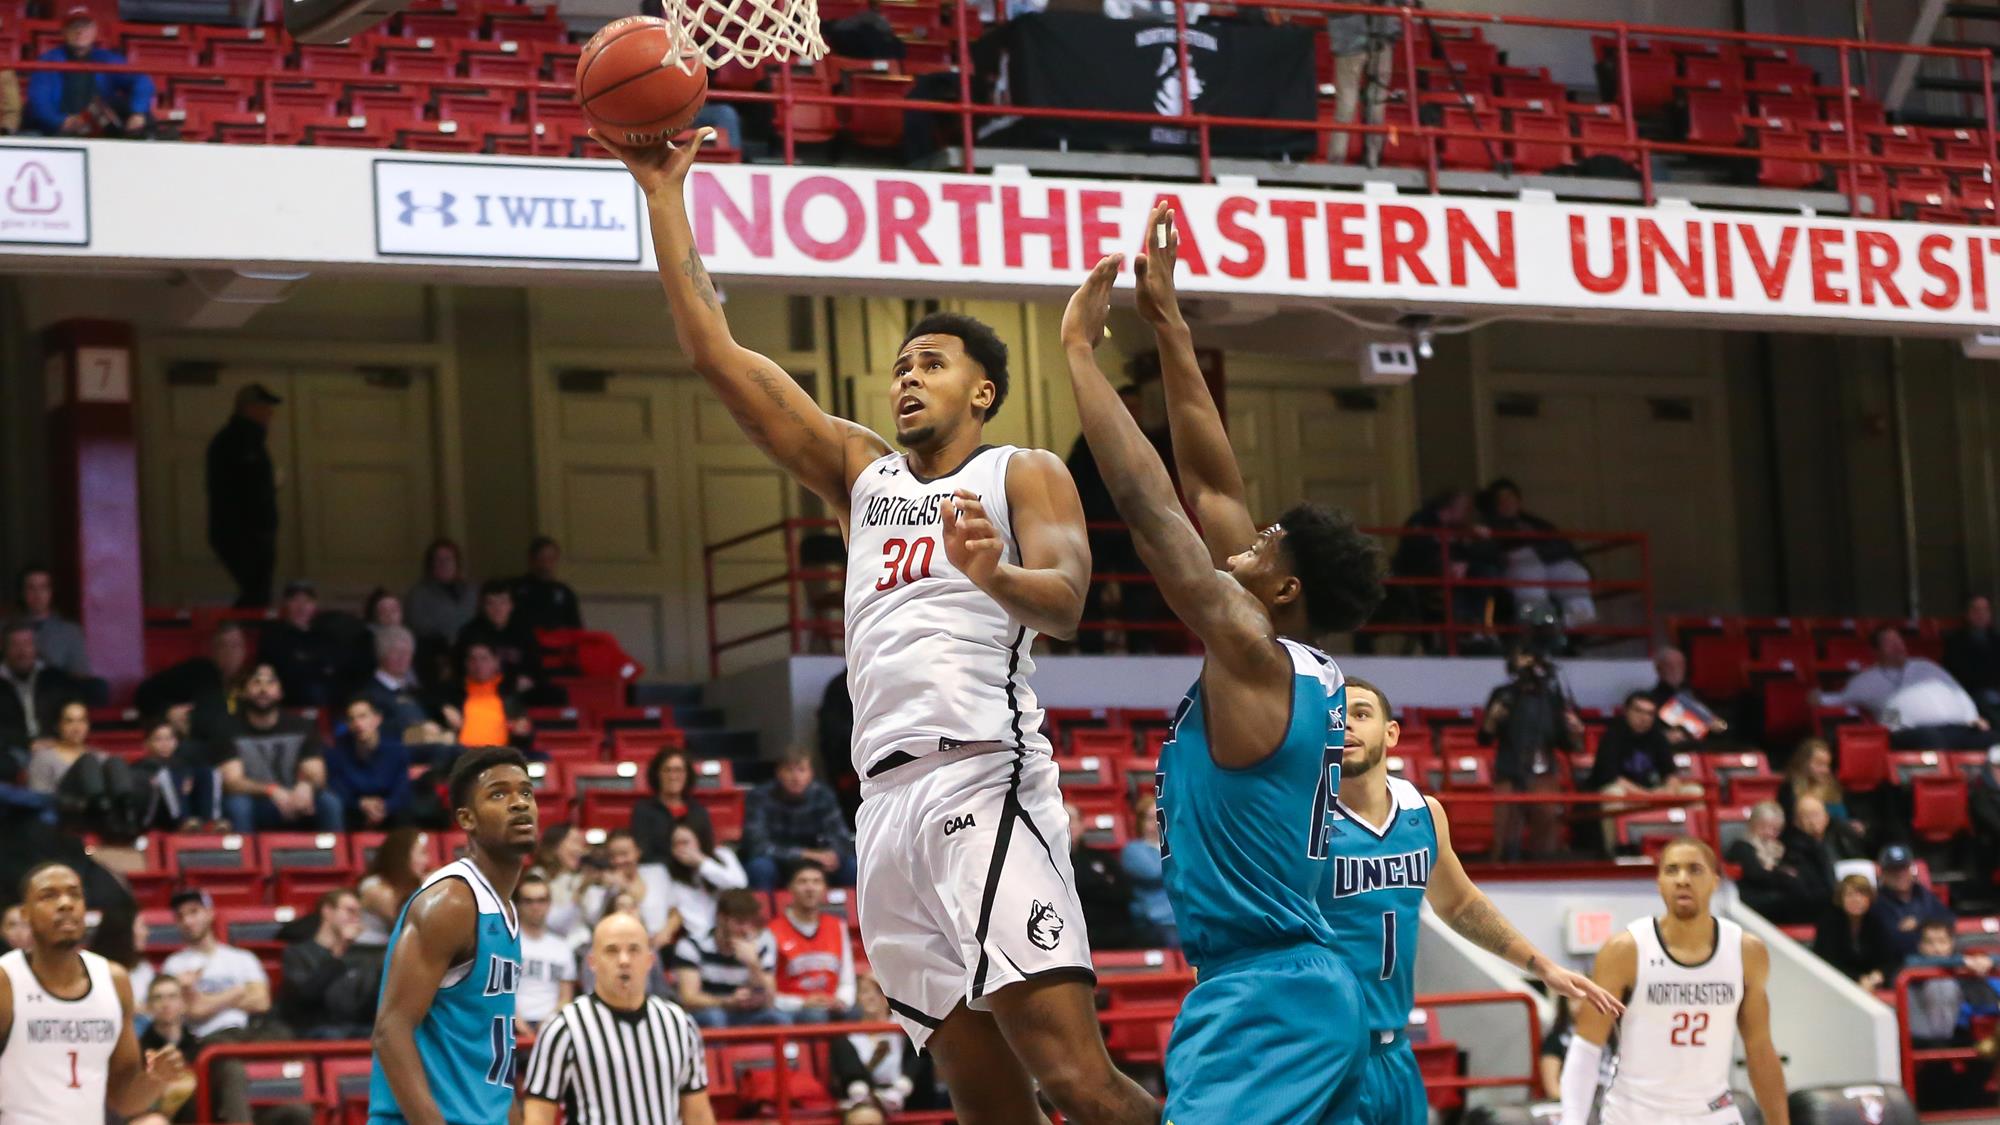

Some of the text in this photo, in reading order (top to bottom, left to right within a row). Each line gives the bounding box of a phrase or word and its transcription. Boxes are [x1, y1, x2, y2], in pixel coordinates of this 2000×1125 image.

[474, 194, 627, 232] I WILL.
[692, 170, 2000, 313] NORTHEASTERN UNIVERSI
[94, 358, 112, 392] 7
[861, 493, 983, 528] NORTHEAST
[875, 536, 935, 591] 30
[943, 813, 977, 837] CAA
[1333, 847, 1431, 899] UNCW
[1379, 910, 1398, 981] 1
[1647, 982, 1735, 1006] NORTHEASTERN
[27, 1018, 116, 1044] NORTHEASTERN
[1669, 1012, 1711, 1048] 22
[66, 1051, 82, 1090] 1
